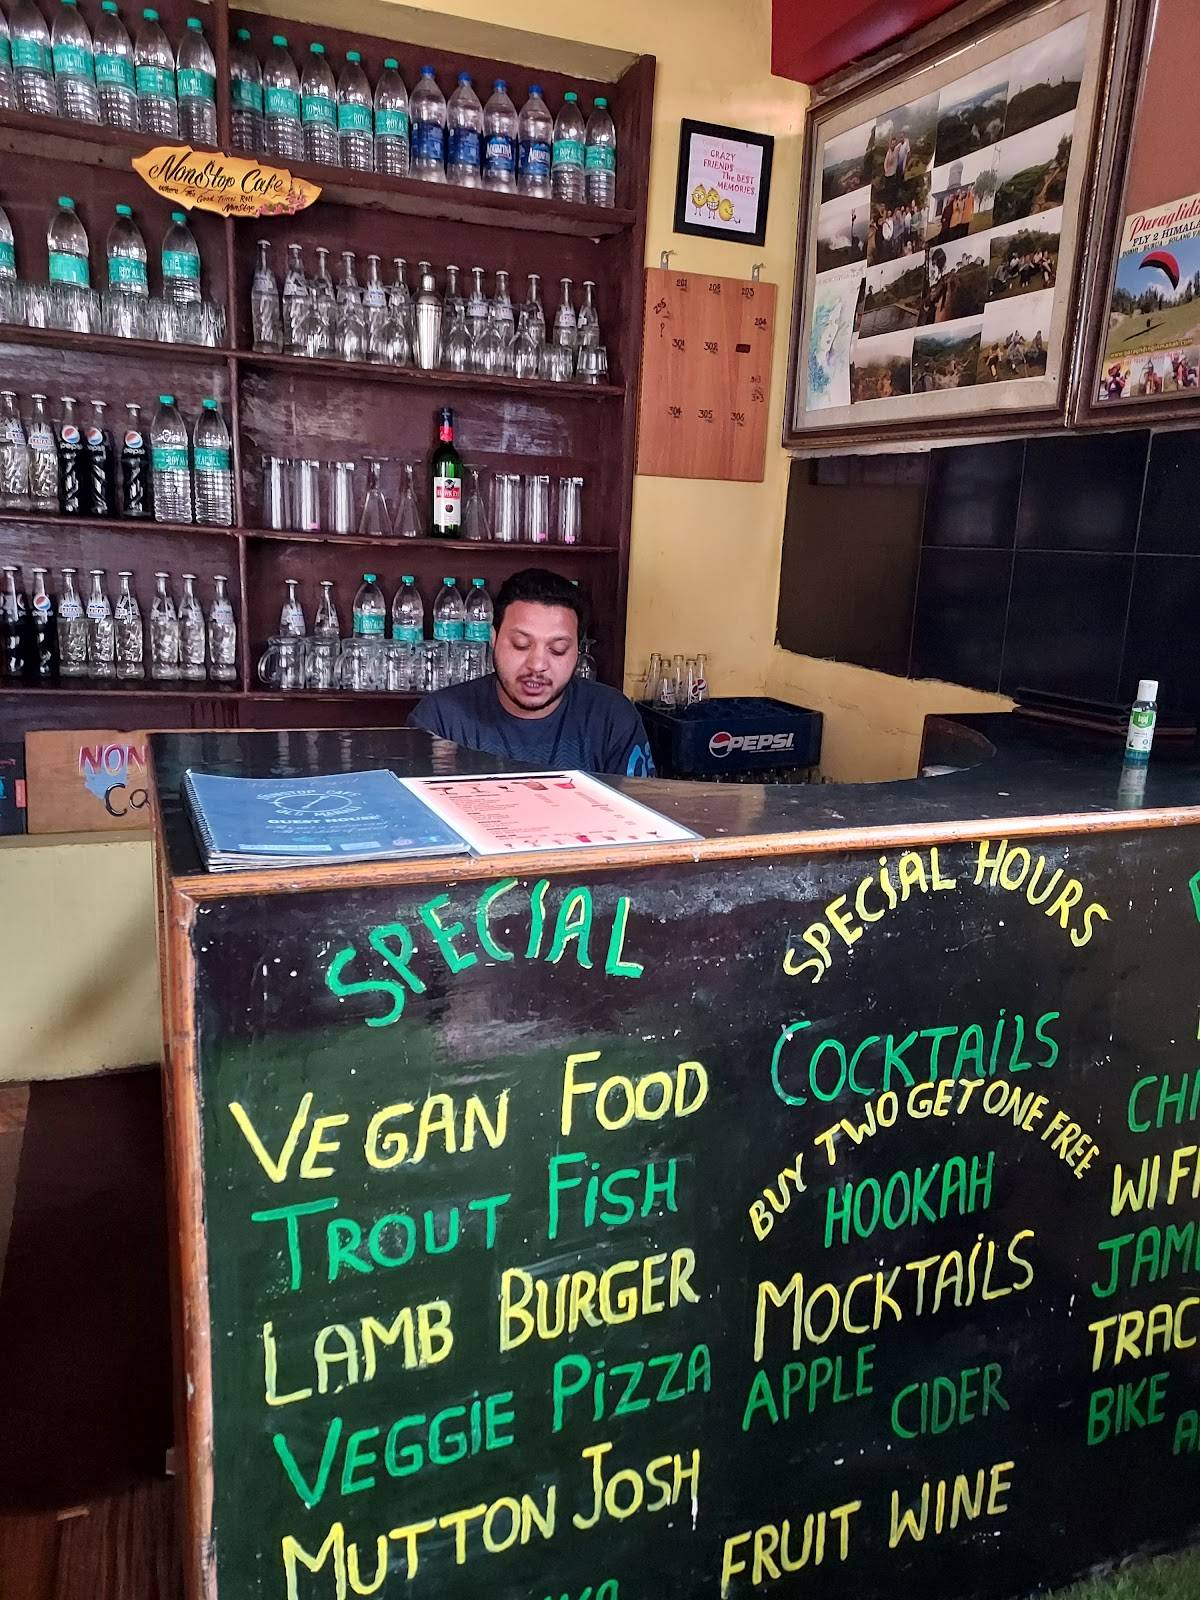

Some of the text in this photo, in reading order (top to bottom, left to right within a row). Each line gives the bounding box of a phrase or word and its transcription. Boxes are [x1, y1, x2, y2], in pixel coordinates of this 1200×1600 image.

[703, 159, 734, 172] FRIENDS
[710, 149, 736, 162] CRAZY
[736, 173, 755, 184] BEST
[1153, 232, 1159, 242] 2
[728, 732, 795, 751] PEPSI
[974, 840, 1112, 948] HOURS
[326, 877, 645, 1027] SPECIAL
[229, 1051, 710, 1184] VEGAN FOOD
[749, 1078, 1100, 1242] BUY TWO GET ONE FREE
[251, 1193, 512, 1291] TROUT
[824, 1151, 995, 1249] HOOKAH
[263, 1247, 700, 1407] LAMB BURGER
[742, 1344, 1011, 1440] APPLE CIDER
[1087, 1371, 1171, 1446] BIKE
[281, 1442, 700, 1600] MUTTON JOSH
[720, 1461, 1015, 1600] FRUIT WINE
